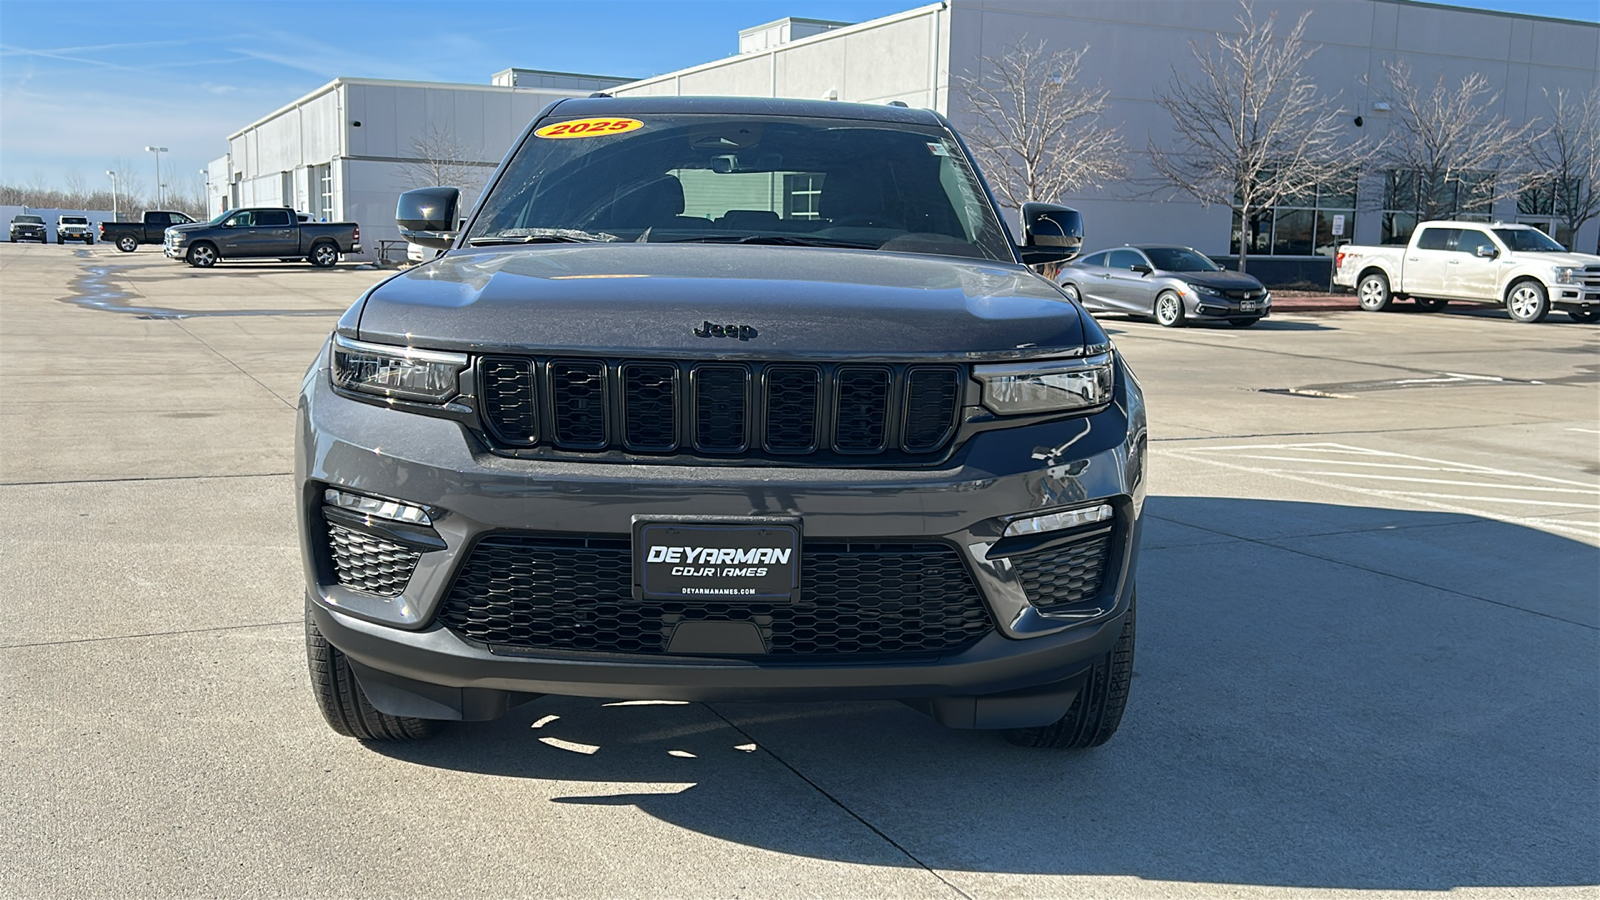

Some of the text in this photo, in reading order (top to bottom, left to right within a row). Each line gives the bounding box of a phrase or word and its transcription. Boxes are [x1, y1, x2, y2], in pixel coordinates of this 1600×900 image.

[546, 120, 633, 136] 2025
[693, 321, 759, 341] Jeep
[647, 546, 792, 565] DEYARMAN
[671, 566, 768, 577] CDJR AMES
[682, 587, 756, 595] DEYARMANAMES.COM
